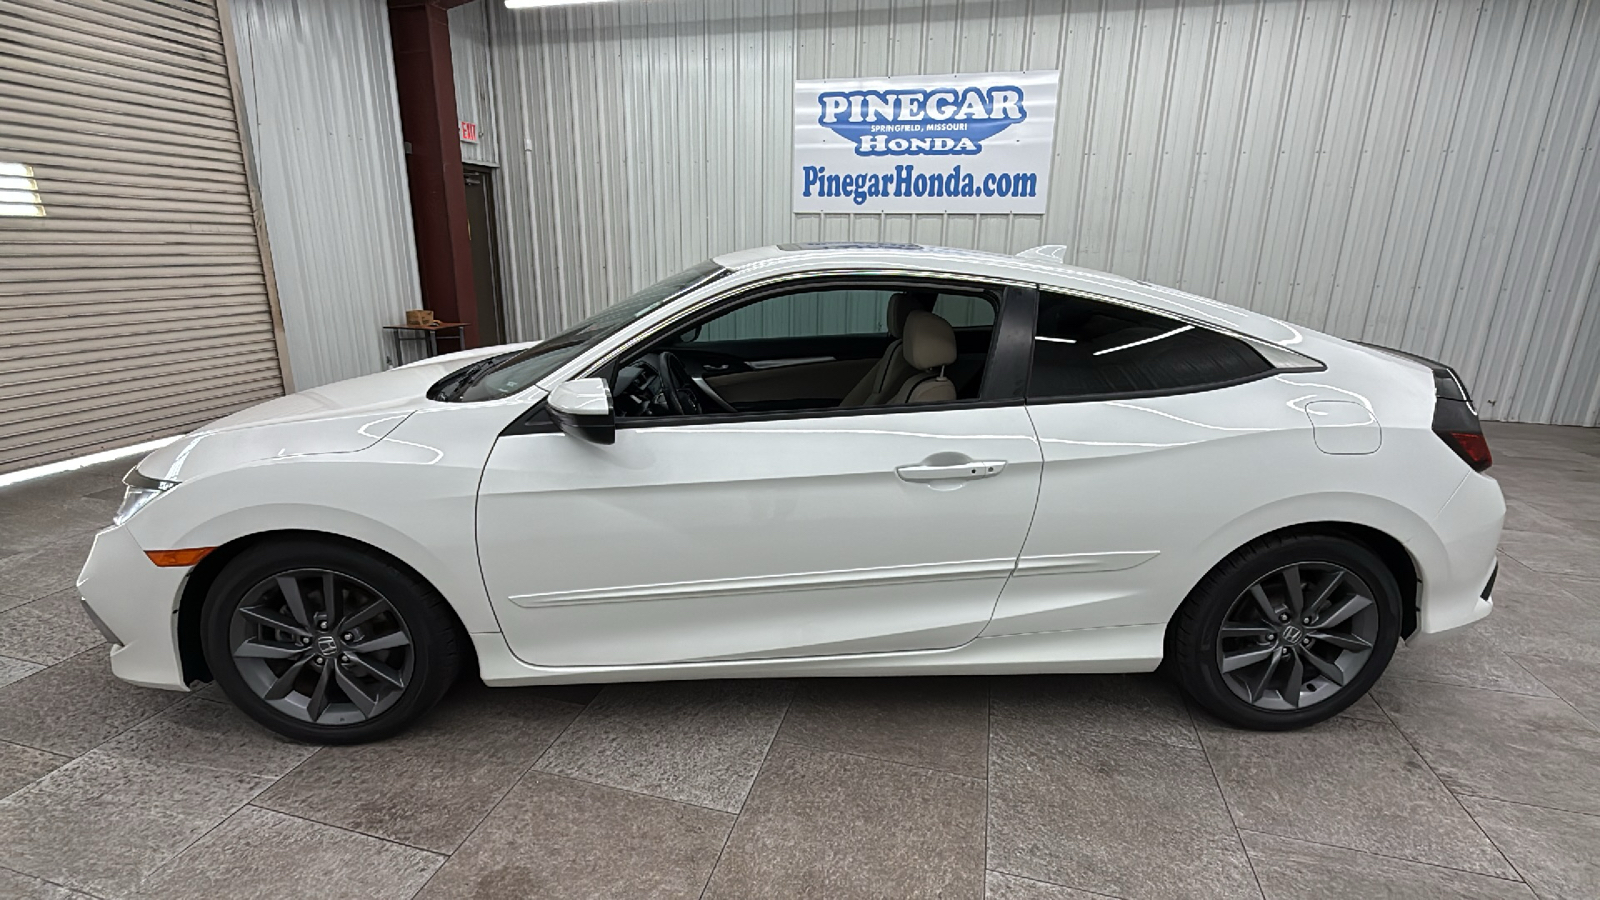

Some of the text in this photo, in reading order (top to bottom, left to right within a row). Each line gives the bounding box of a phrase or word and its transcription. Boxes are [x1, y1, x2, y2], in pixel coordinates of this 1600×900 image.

[821, 88, 1025, 125] PINEGAR
[461, 121, 476, 141] EXIT
[870, 122, 968, 133] SPRINGFIELD, MISSOURI
[802, 164, 1037, 205] PinegarHonda.com
